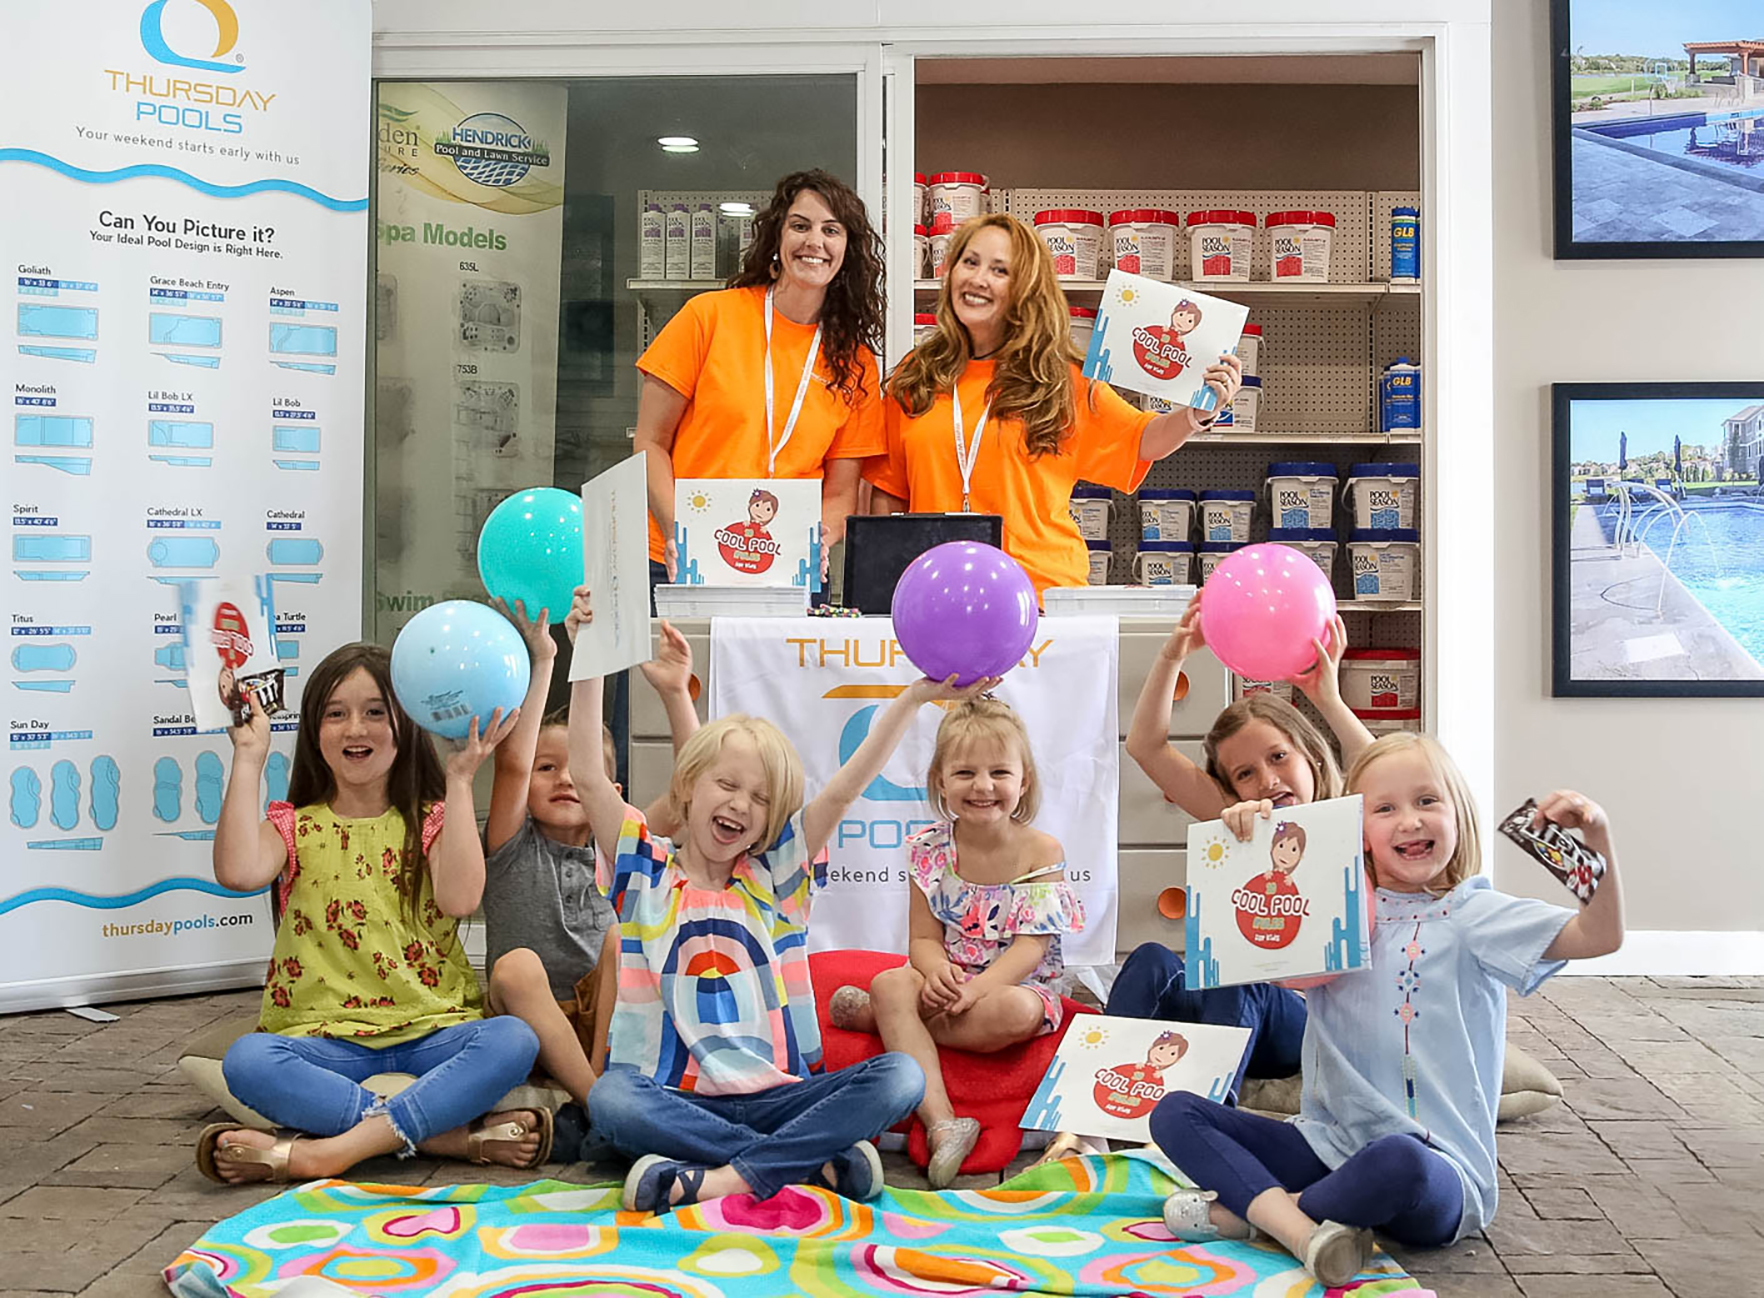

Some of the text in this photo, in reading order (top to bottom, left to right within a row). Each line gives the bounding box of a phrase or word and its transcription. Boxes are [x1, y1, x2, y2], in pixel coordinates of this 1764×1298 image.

[104, 69, 277, 112] THURSDAY
[136, 101, 243, 134] POOLS
[453, 127, 531, 149] HENDRICK
[76, 126, 300, 165] Your weekend starts early with us
[436, 145, 547, 165] Pool and Lawn Service
[99, 210, 275, 244] Can You Picture it?
[1394, 227, 1414, 238] GLB
[424, 223, 507, 250] Models
[89, 230, 283, 259] Your Ideal Pool Design is Right Here.
[1202, 244, 1230, 252] SEASON
[1275, 244, 1301, 253] SEASON
[18, 265, 51, 275] Goliath
[150, 276, 230, 293] Grace Beach Entry
[270, 286, 295, 298] Aspen
[1132, 327, 1192, 368] COOL POOL
[1392, 377, 1412, 386] GLB
[15, 384, 56, 395] Monolith
[148, 391, 193, 401] Lil Bob LX
[273, 398, 300, 407] Lil Bob
[1280, 497, 1307, 506] SEASON
[1370, 497, 1399, 506] SEASON
[13, 504, 38, 514] Spirit
[147, 507, 202, 516] Cathedral LX
[267, 510, 305, 518] Cathedral
[714, 529, 781, 555] COOL POOL
[12, 615, 33, 623] Titus
[1371, 681, 1398, 690] SEASON
[10, 720, 49, 730] Sun Day
[153, 716, 182, 724] Sandal
[1070, 869, 1091, 882] us
[1232, 889, 1310, 916] COOL POOL
[102, 911, 253, 937] thursdaypools.com
[1094, 1068, 1165, 1100] COOL POO
